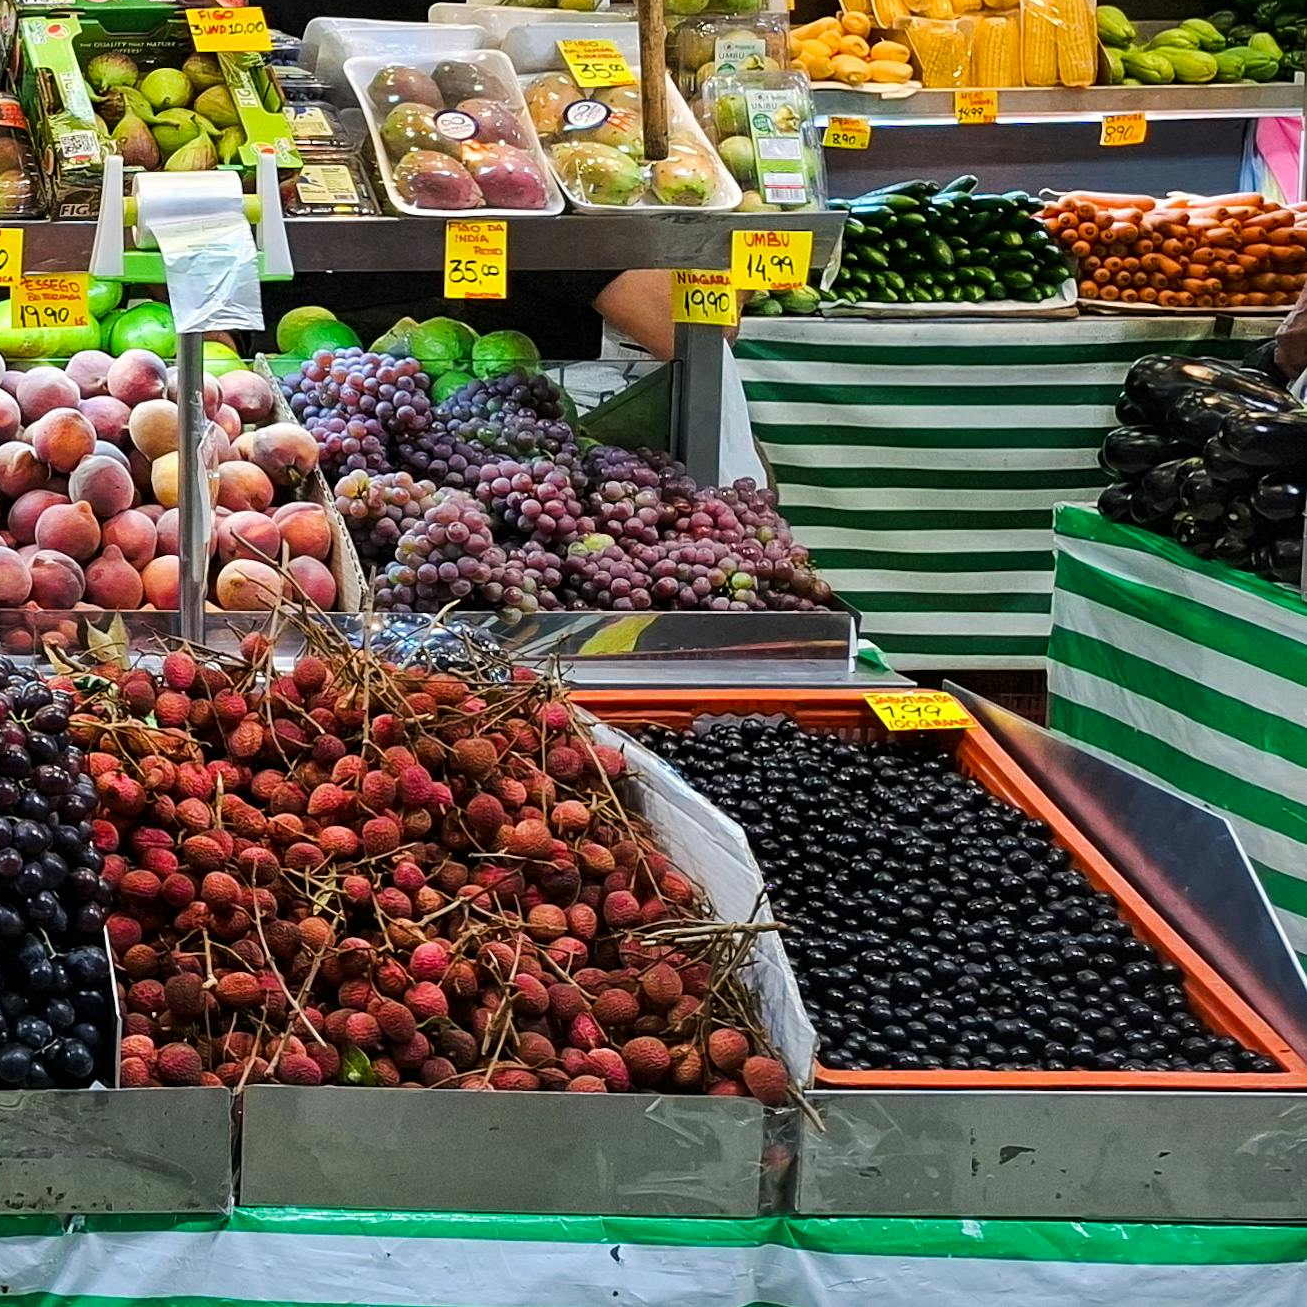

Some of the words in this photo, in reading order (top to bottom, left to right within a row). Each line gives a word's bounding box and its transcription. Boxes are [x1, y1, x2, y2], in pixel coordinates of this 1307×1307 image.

[198, 10, 234, 20] FIGO
[190, 24, 203, 36] 3
[487, 224, 504, 232] DA
[744, 232, 790, 247] UMBU
